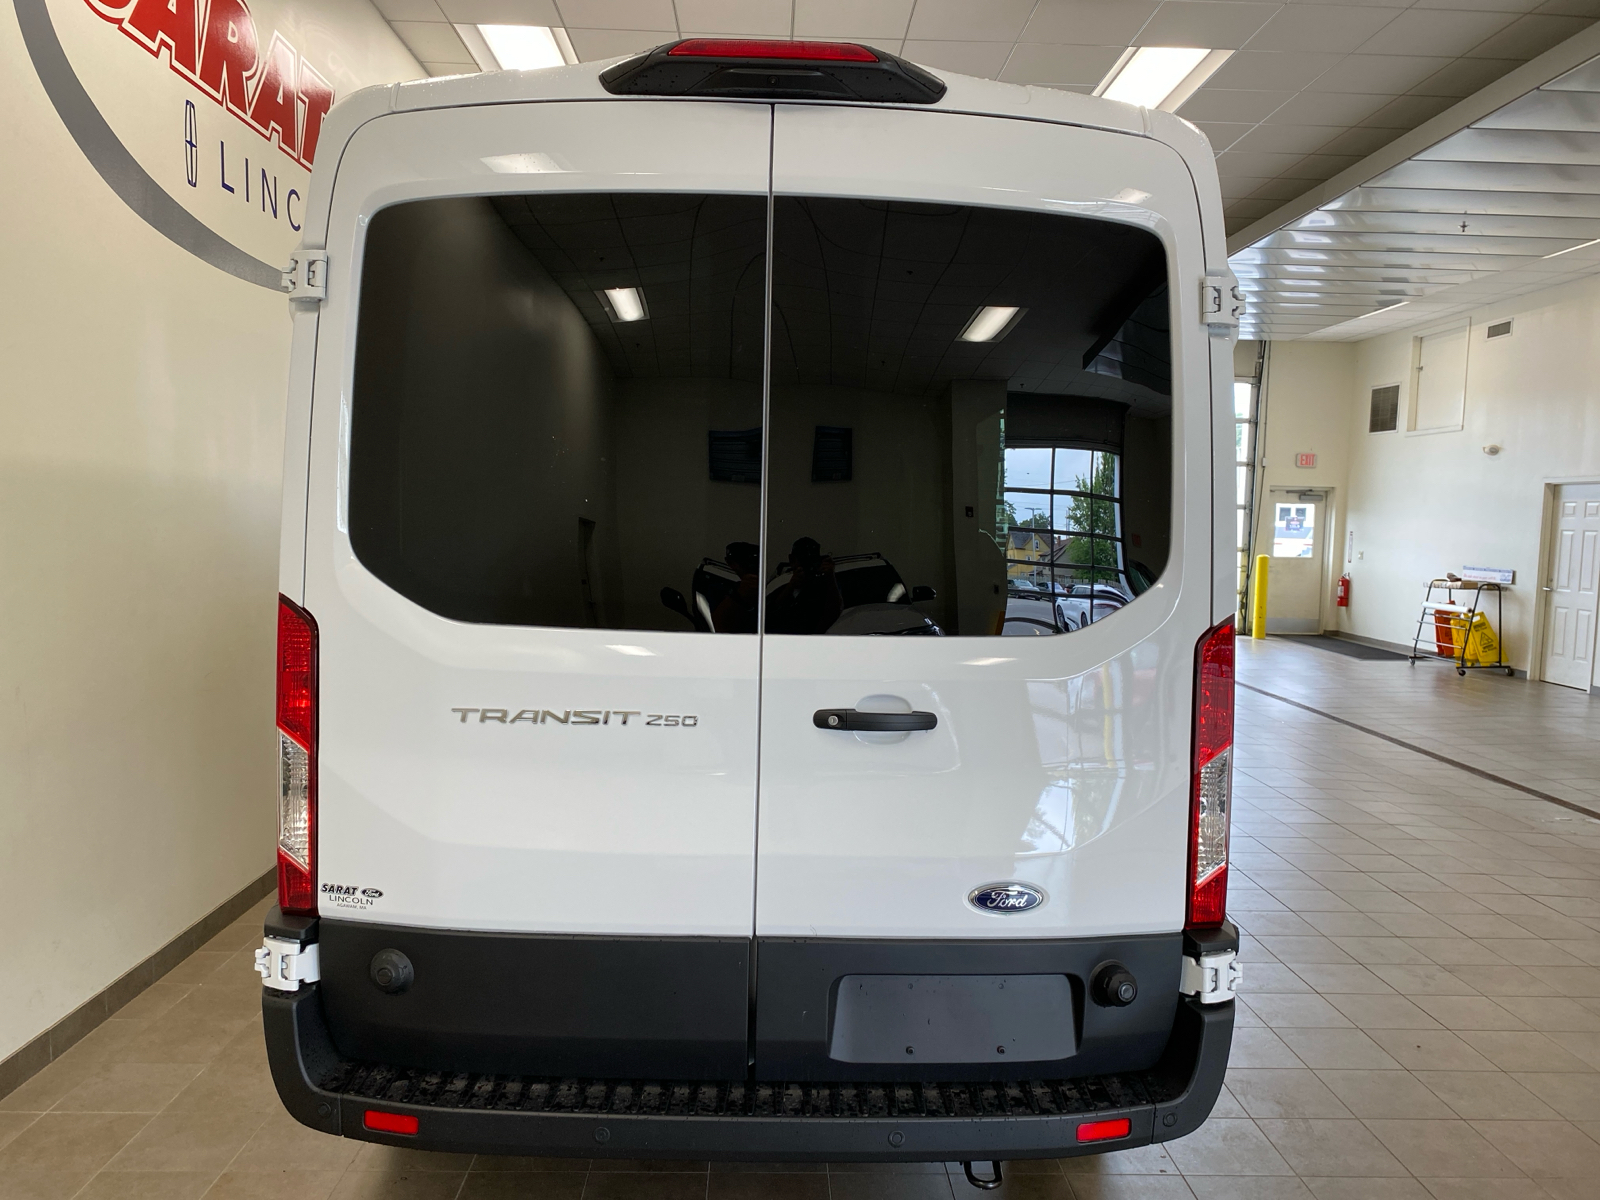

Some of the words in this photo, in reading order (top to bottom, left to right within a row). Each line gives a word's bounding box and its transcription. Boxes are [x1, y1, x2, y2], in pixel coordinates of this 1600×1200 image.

[84, 0, 335, 173] ARAT
[1299, 453, 1315, 466] EXIT
[451, 708, 641, 725] TRANSIT
[645, 714, 699, 727] 250
[321, 883, 359, 895] SARAT
[329, 895, 373, 906] LINCOLN
[986, 890, 1028, 907] Ford
